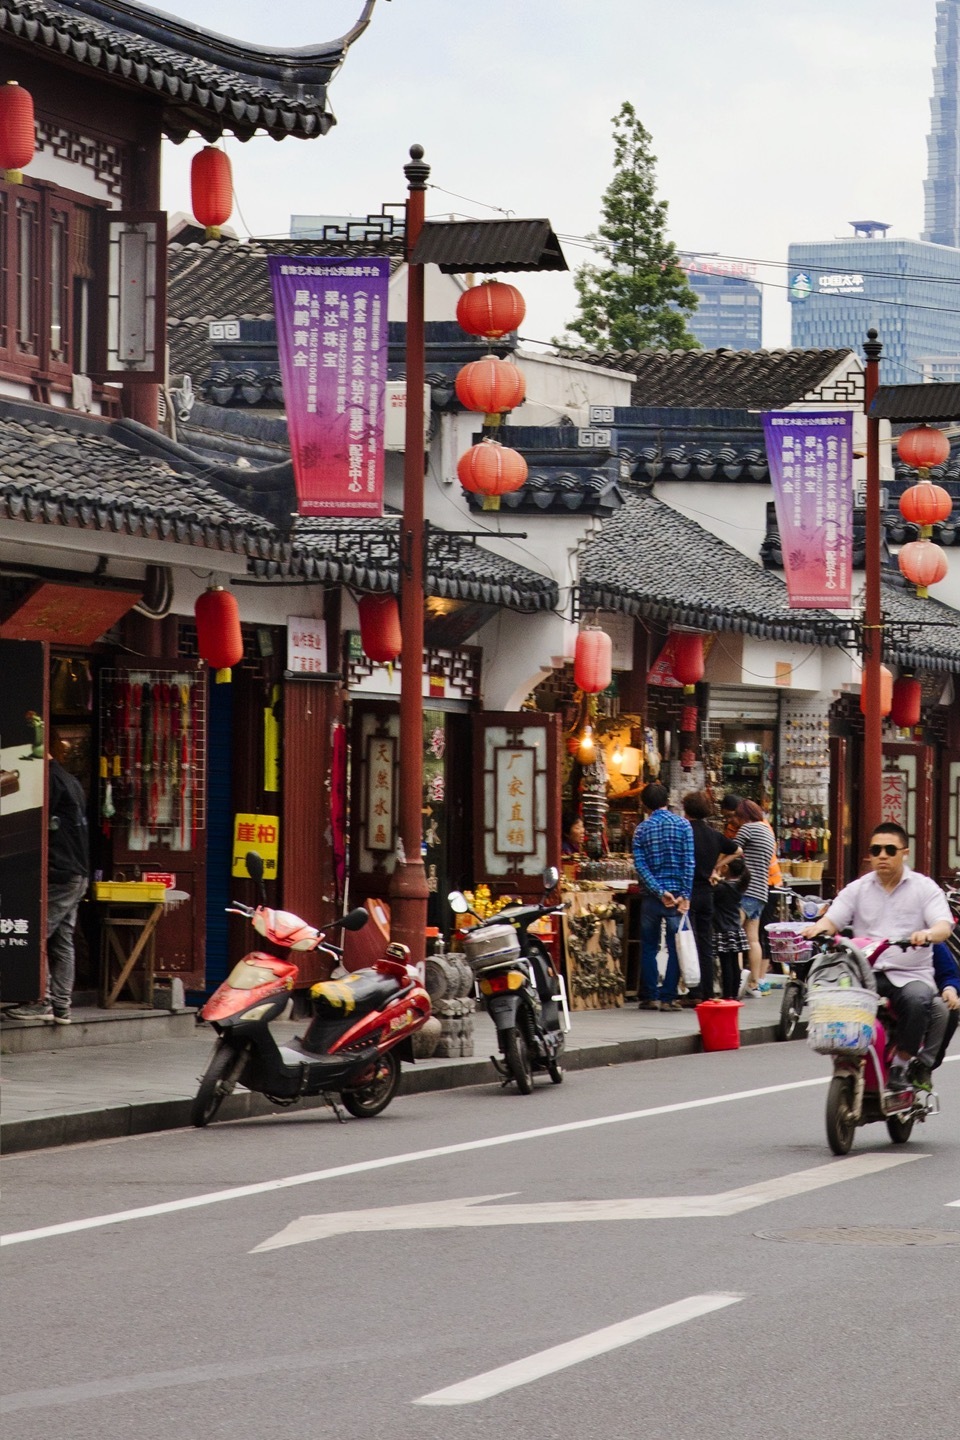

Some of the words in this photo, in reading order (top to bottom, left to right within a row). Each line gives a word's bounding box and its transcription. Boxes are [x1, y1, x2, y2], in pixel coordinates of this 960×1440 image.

[819, 275, 864, 286] 中国太平
[374, 744, 390, 844] 天然水晶
[506, 753, 526, 847] 厂家直销
[238, 822, 276, 843] 崖柏
[233, 856, 275, 869] 厂销
[0, 919, 29, 934] 砂壶
